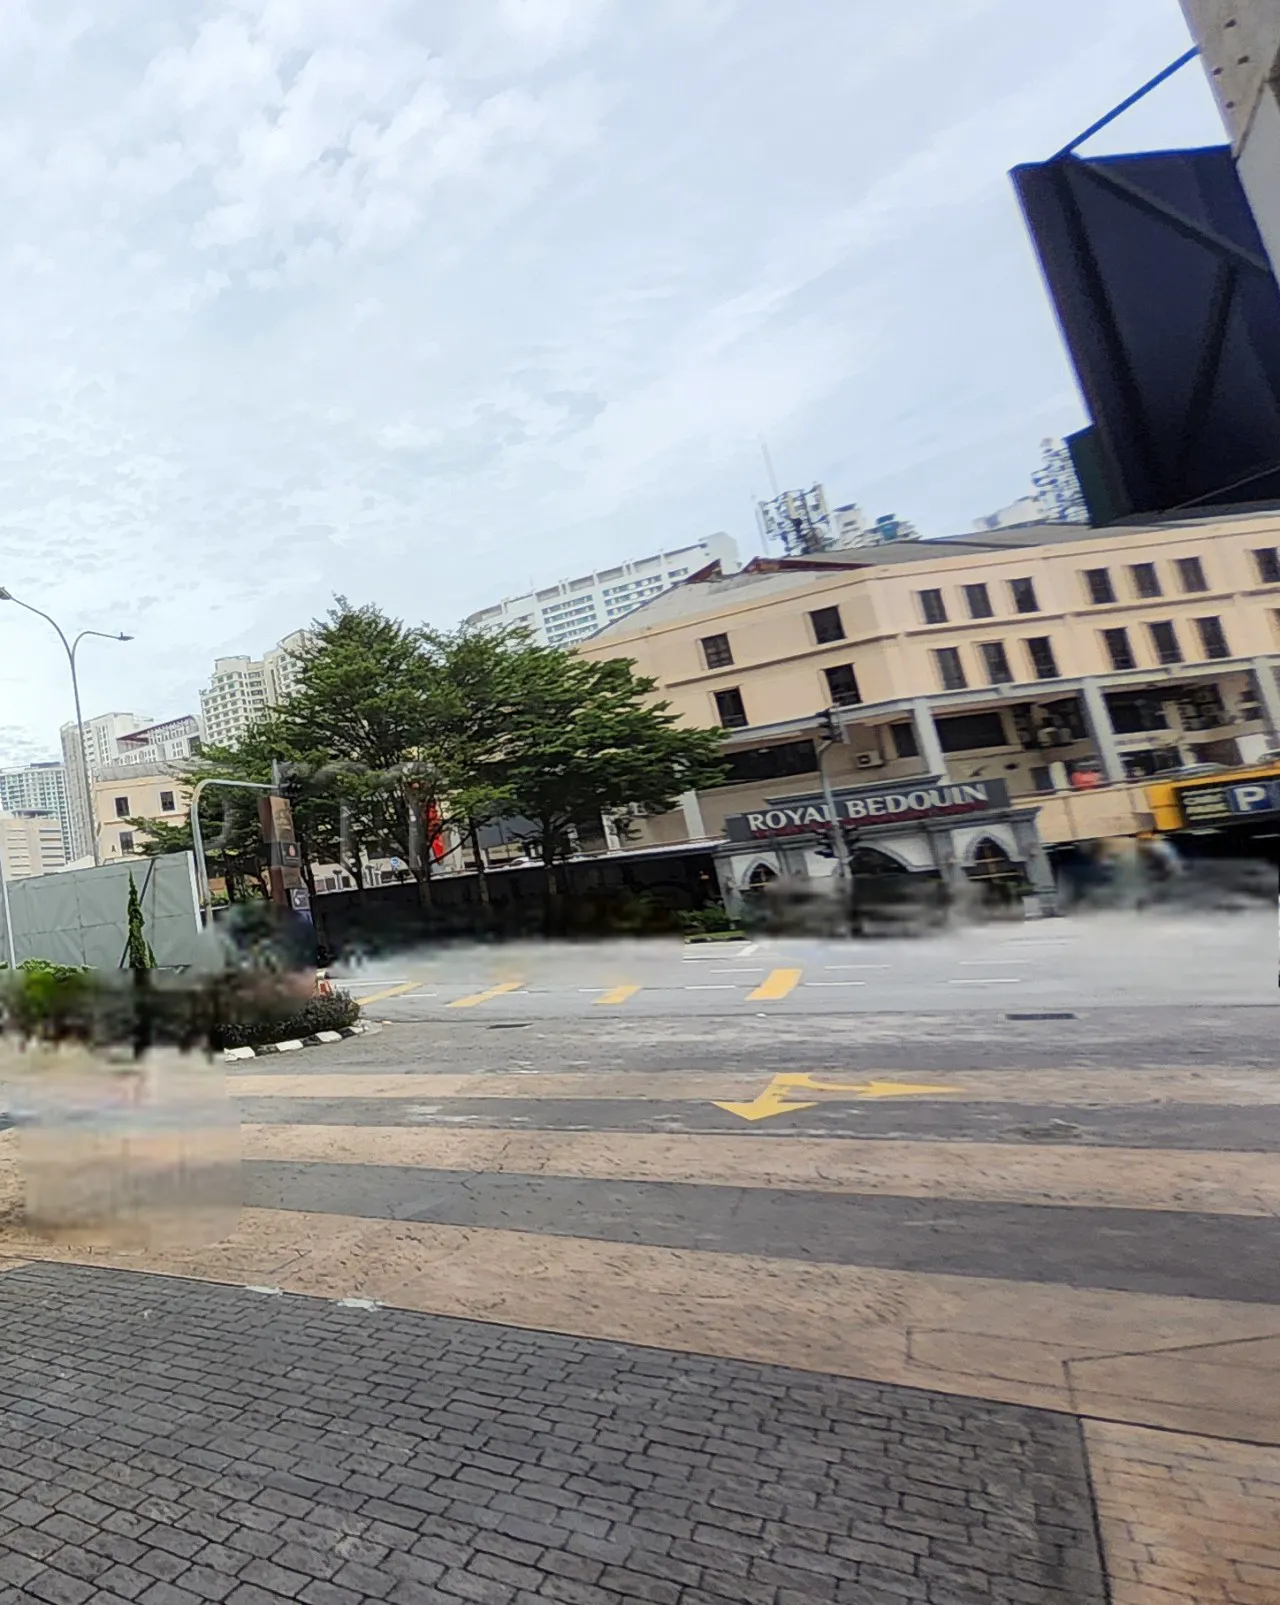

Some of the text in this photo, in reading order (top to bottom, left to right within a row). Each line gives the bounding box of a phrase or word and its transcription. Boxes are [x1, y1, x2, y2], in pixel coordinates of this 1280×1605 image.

[746, 784, 988, 831] ROYAL BEDOUIN
[1234, 786, 1265, 811] P
